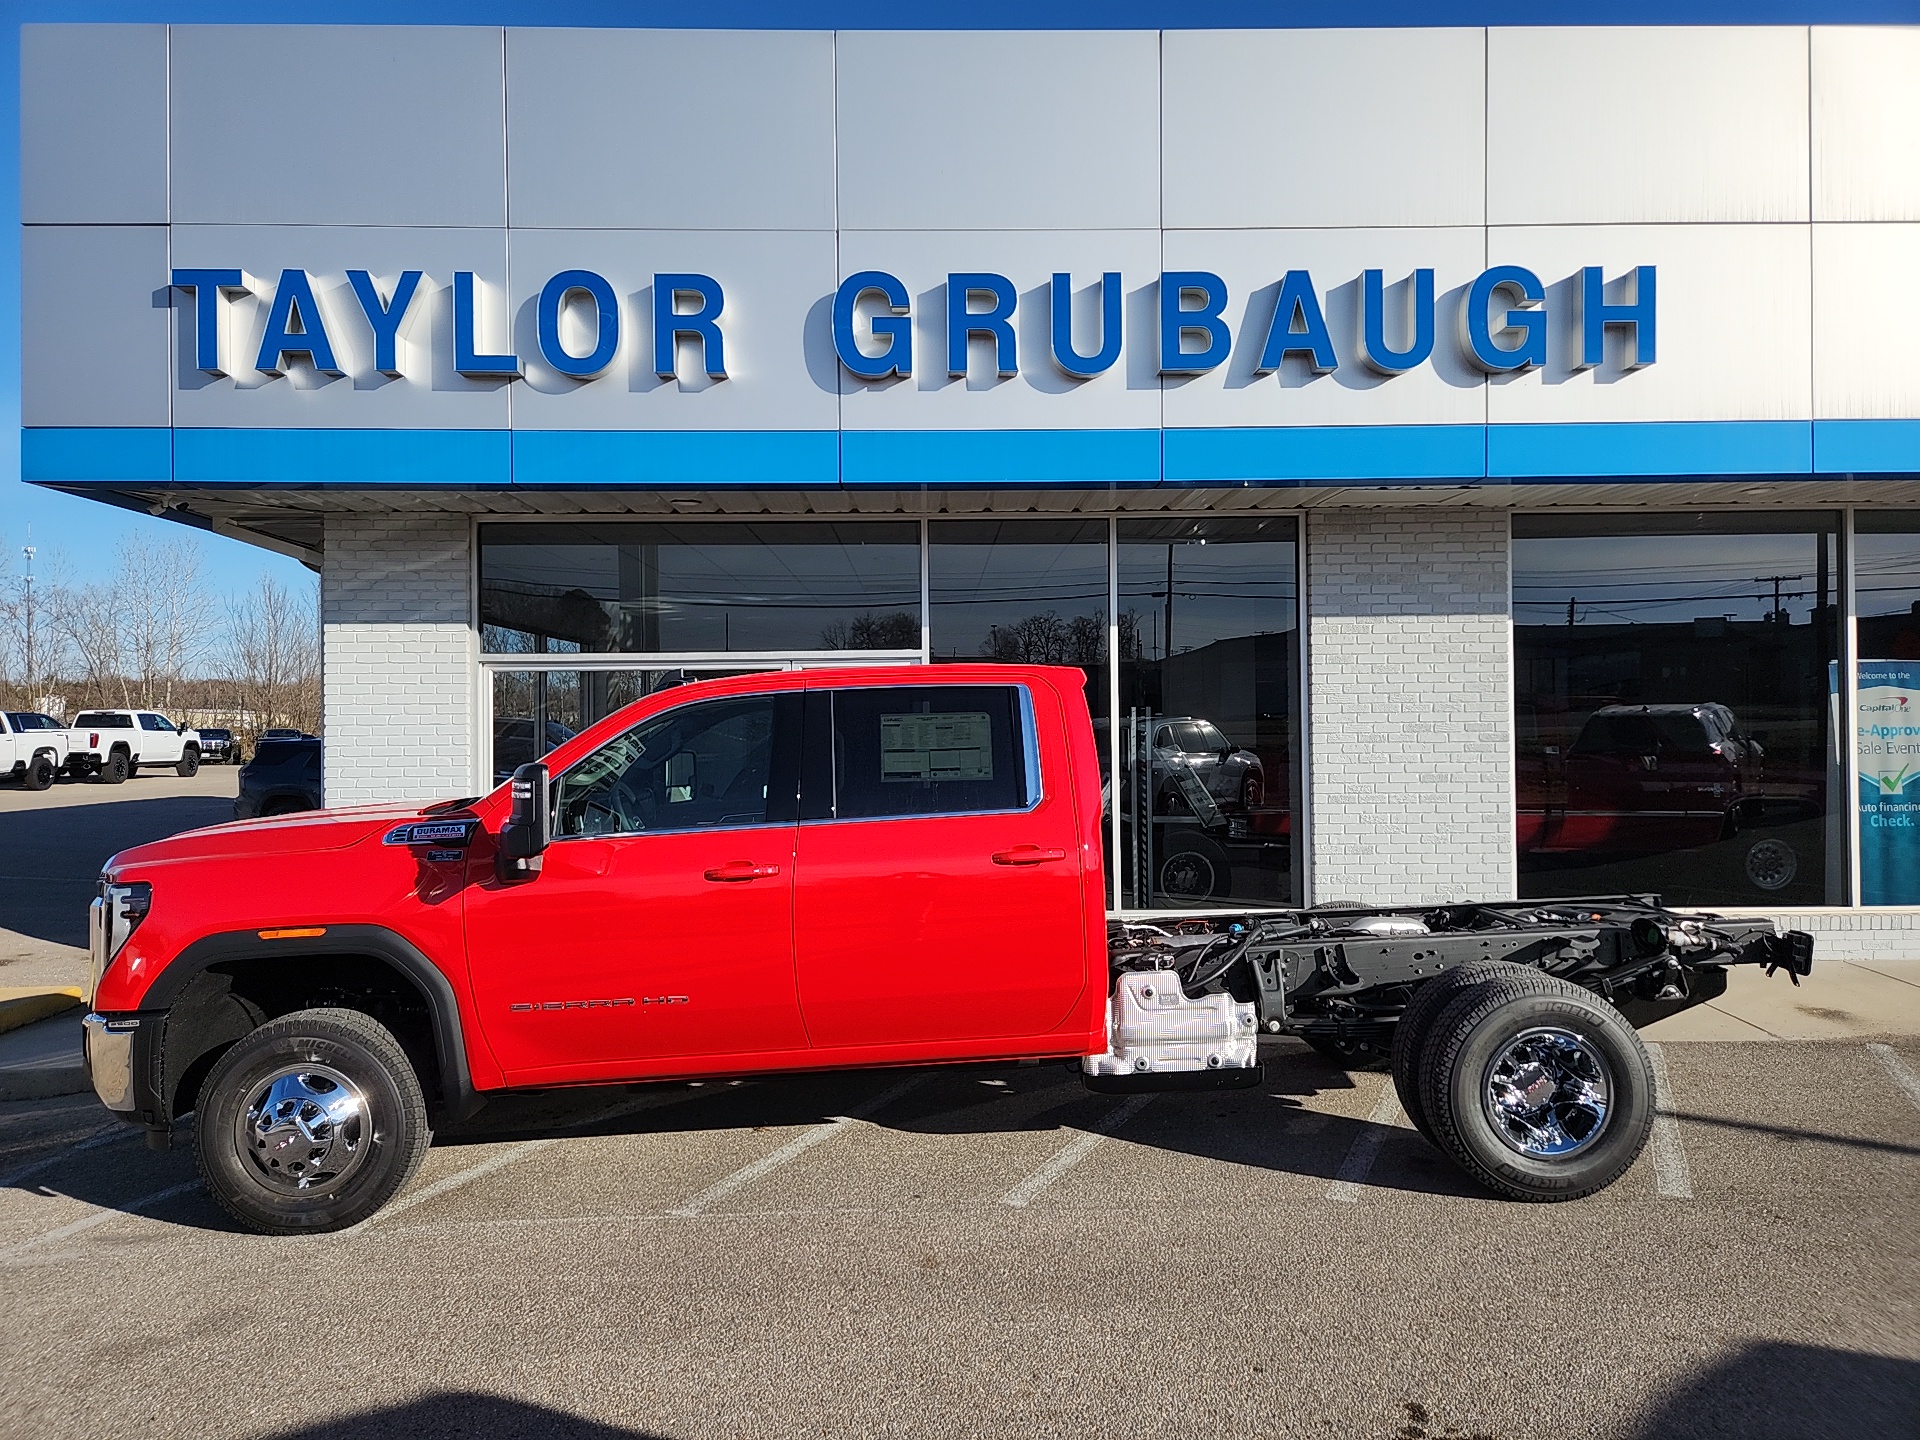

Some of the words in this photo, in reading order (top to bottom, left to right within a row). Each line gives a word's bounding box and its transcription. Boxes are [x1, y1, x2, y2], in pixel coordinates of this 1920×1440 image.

[171, 268, 728, 379] TAYLOR
[831, 265, 1657, 378] GRUBAUGH
[1888, 672, 1897, 680] to
[1897, 671, 1911, 680] the
[1857, 741, 1882, 755] Sale
[1886, 741, 1920, 755] Event
[1870, 813, 1915, 827] Check.
[416, 826, 463, 835] DURAMAX
